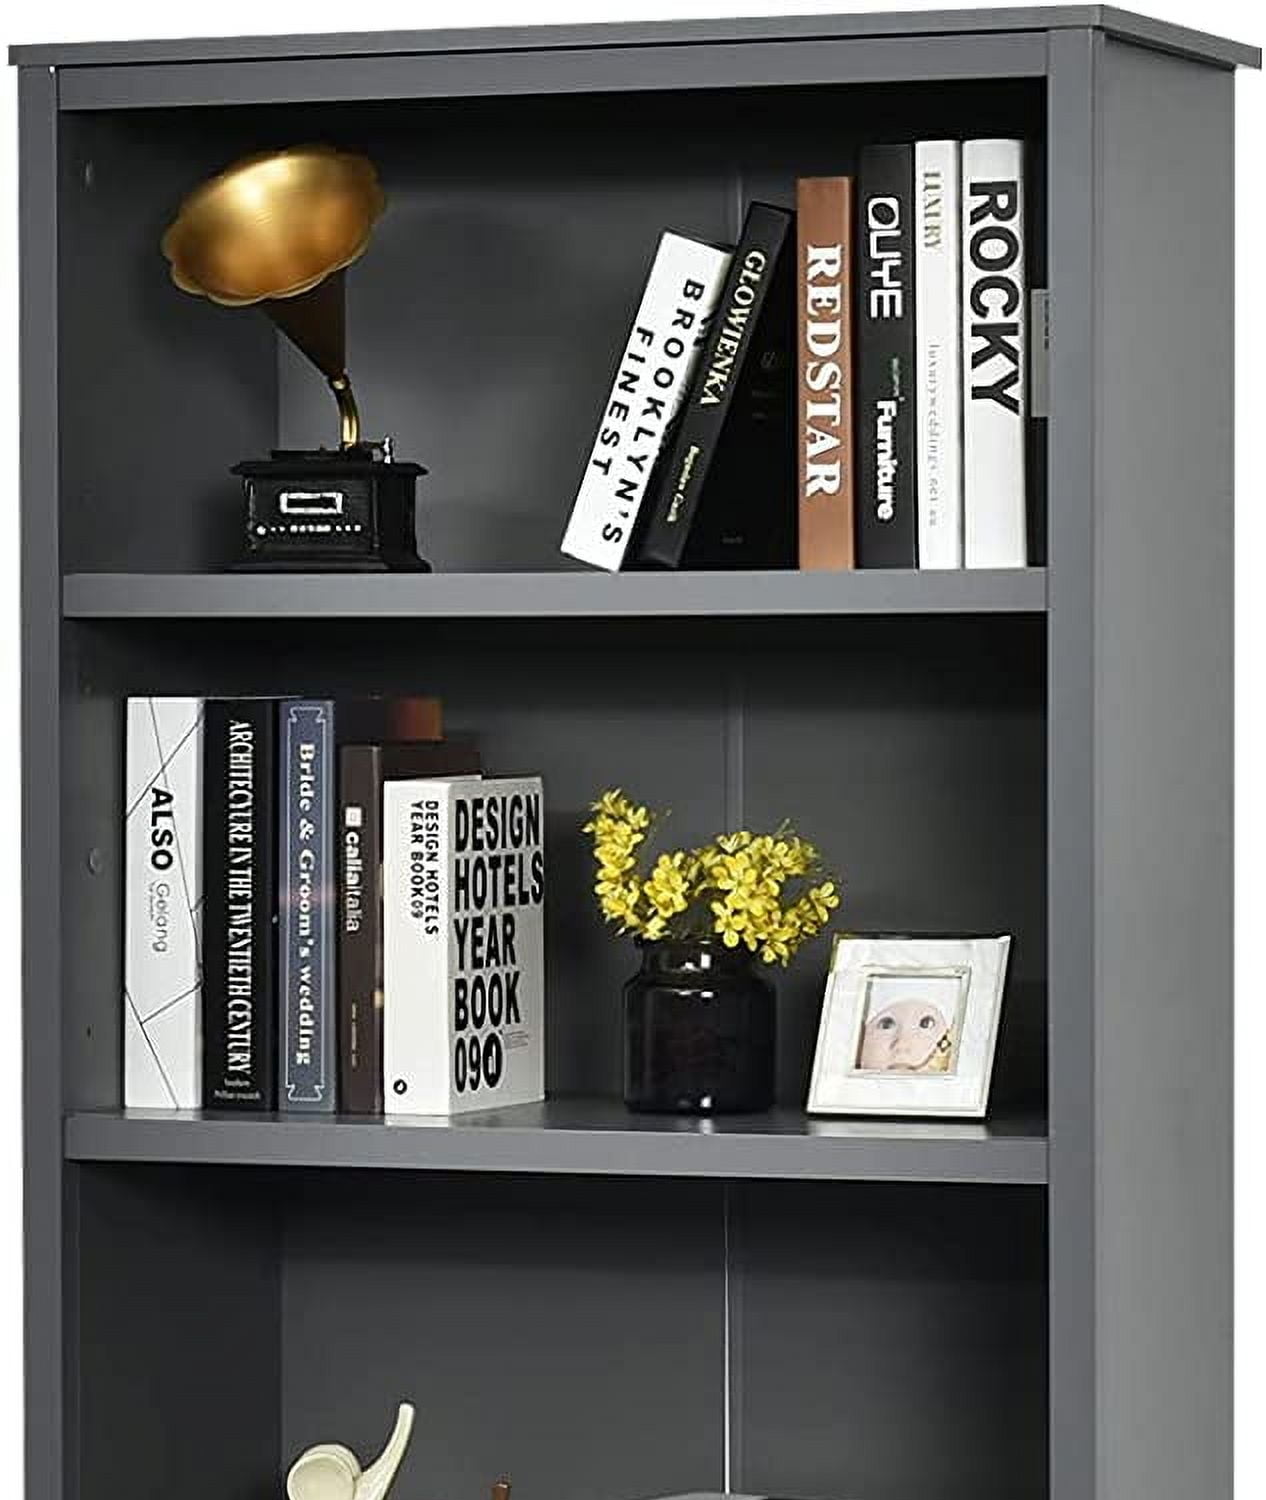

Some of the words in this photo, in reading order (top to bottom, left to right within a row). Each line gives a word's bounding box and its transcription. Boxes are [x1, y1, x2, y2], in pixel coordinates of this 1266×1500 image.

[922, 171, 943, 250] LUXURY
[969, 180, 1020, 416] ROCKY
[592, 325, 655, 475] FINEST
[805, 243, 842, 497] REDSTAR
[602, 278, 705, 544] BROOKLYN'S
[876, 400, 899, 520] Furniture
[298, 742, 316, 812] Bride
[150, 787, 174, 871] ALSO
[298, 818, 314, 842] &
[410, 800, 424, 844] YEAR
[425, 800, 439, 862] DESIGN
[454, 793, 540, 852] DESIGN
[227, 868, 252, 900] THE
[298, 848, 314, 958] Groom's
[425, 869, 439, 935] HOTELS
[454, 851, 544, 912] HOTELS
[227, 903, 252, 995] TWENTIETH
[453, 913, 516, 971] YEAR
[227, 998, 252, 1074] CENTURY
[295, 966, 314, 1066] wedding
[454, 971, 521, 1031] BOOK
